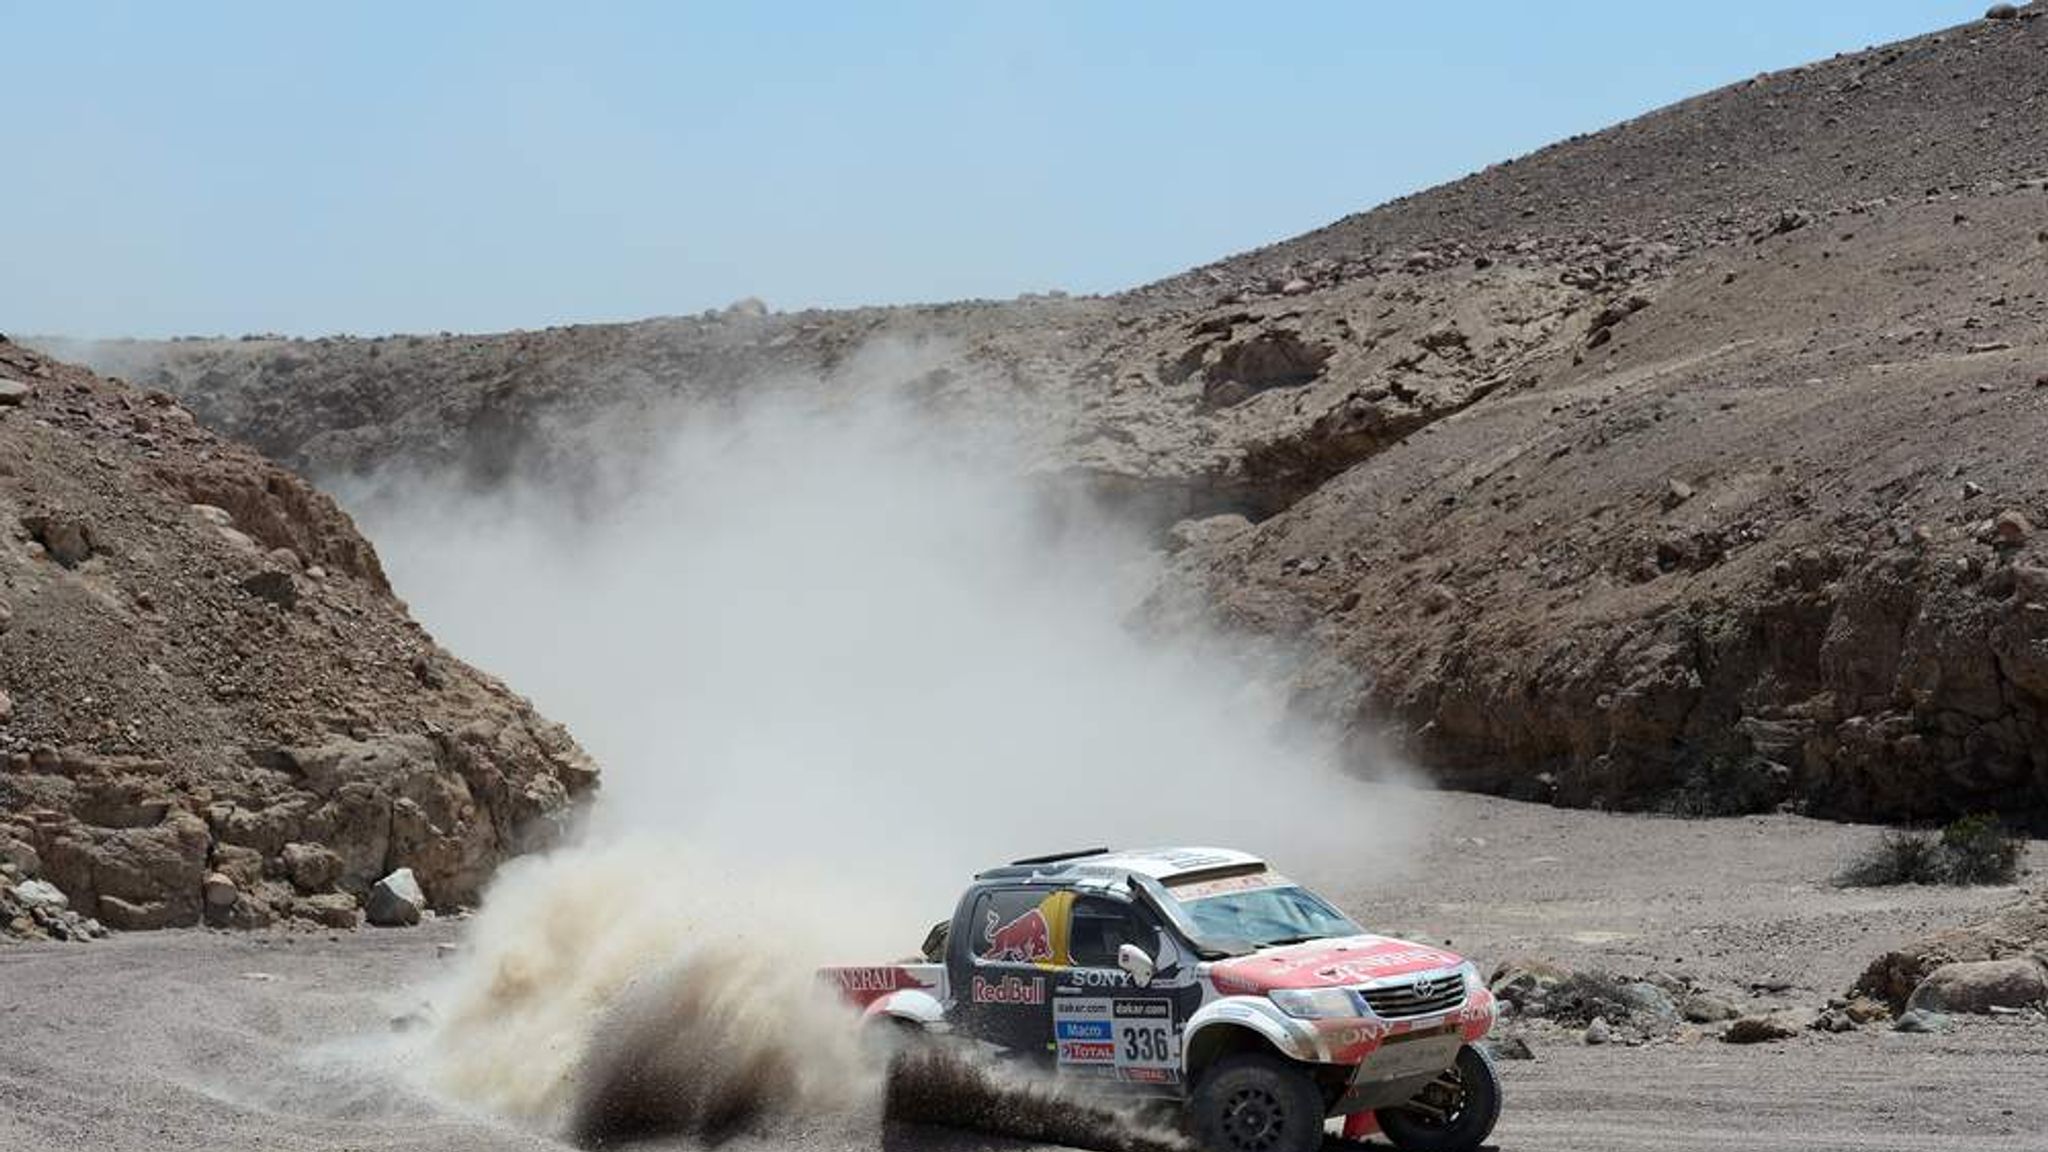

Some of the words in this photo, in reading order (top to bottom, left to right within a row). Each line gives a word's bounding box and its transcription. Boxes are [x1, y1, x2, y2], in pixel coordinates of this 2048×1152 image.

[818, 968, 897, 990] NERALI
[1072, 970, 1132, 987] SONY
[973, 976, 1009, 1004] Red
[1009, 977, 1045, 1004] Bull
[1116, 1003, 1166, 1014] dakar.com
[1460, 1005, 1490, 1020] SON
[1072, 1045, 1113, 1058] TOTAL
[1124, 1027, 1168, 1060] 336
